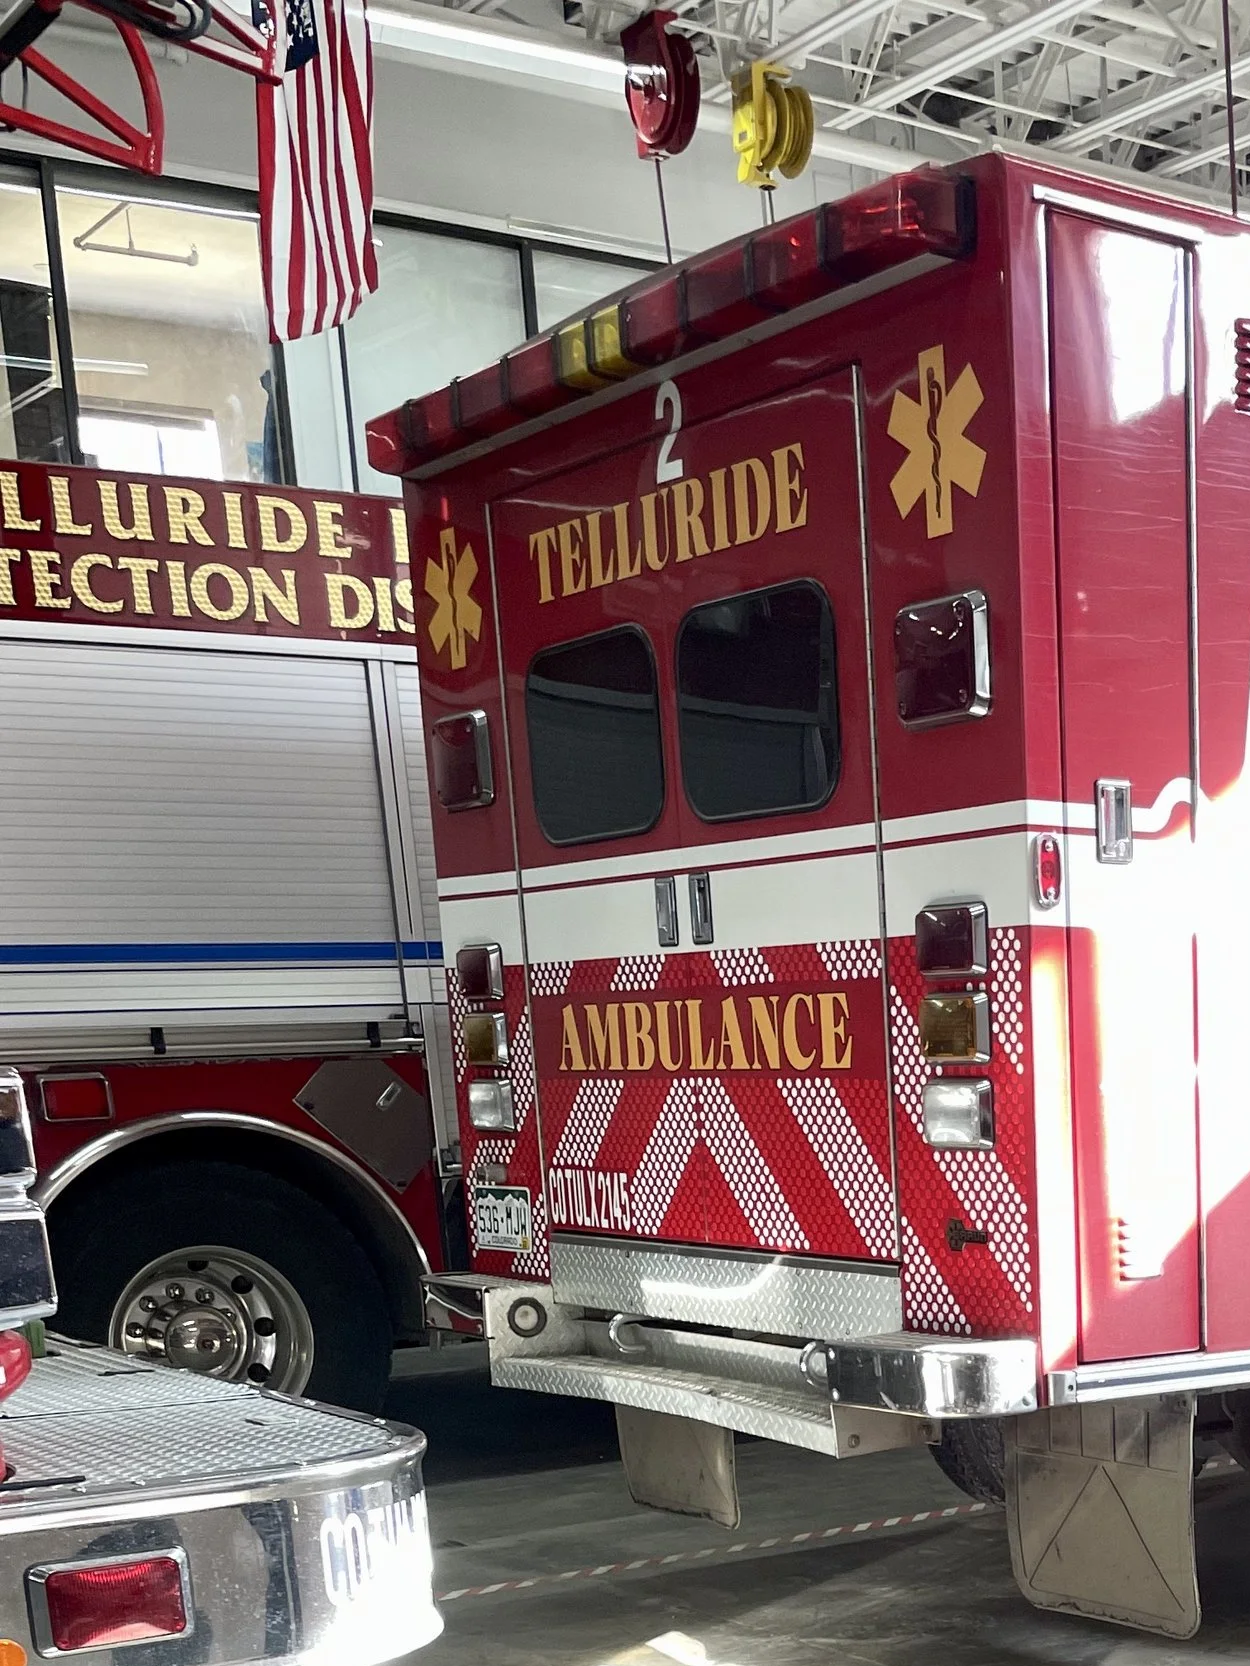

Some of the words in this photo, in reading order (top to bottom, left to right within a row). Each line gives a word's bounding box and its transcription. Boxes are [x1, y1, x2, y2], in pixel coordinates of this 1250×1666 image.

[654, 379, 683, 484] 2
[529, 442, 808, 604] TELLURIDE
[558, 992, 853, 1072] AMBULANCE
